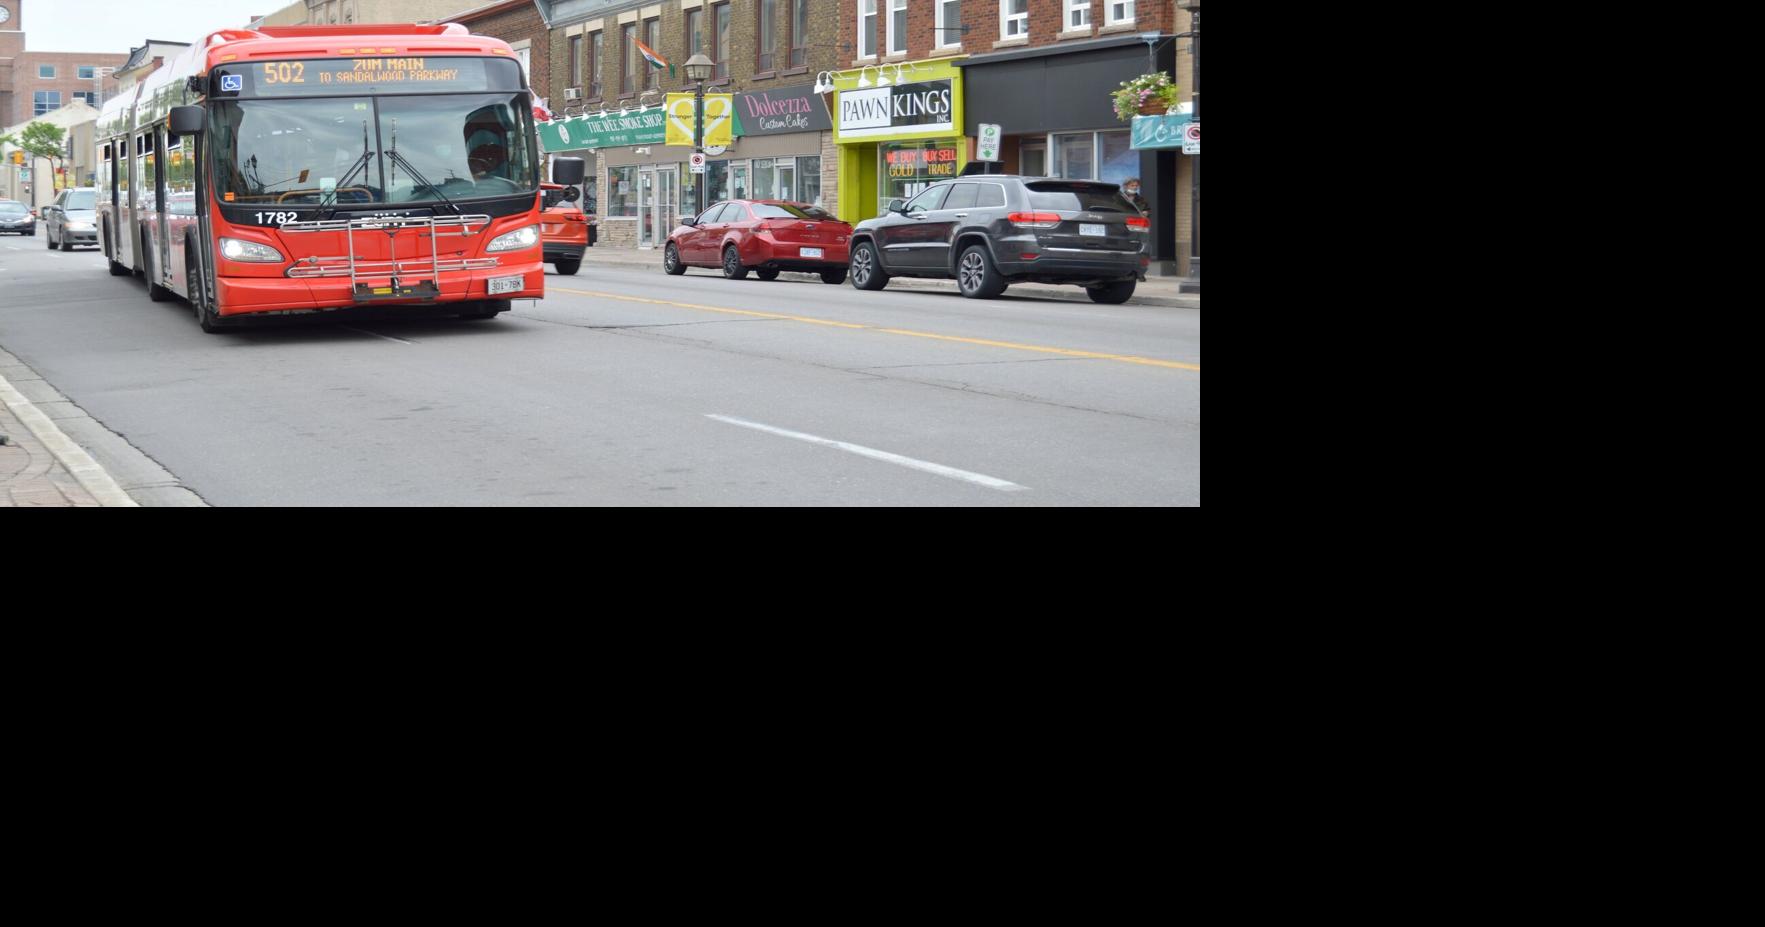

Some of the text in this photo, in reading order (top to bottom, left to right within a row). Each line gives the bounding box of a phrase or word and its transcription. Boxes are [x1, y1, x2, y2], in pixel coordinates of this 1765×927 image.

[387, 57, 424, 71] MAIN
[265, 62, 305, 84] 502
[319, 68, 459, 84] TO SANDALWOOD PARKWAY
[744, 93, 812, 118] Dolcezza
[843, 89, 950, 122] PAWN KINGS
[587, 121, 604, 133] THE
[620, 116, 644, 130] SMOKE
[643, 113, 663, 128] SHOP
[760, 113, 809, 130] Custom Cakes
[981, 143, 997, 151] HERE
[887, 152, 897, 163] WE
[938, 149, 957, 161] SELL
[889, 163, 914, 177] GOLD
[927, 163, 953, 175] TRADE
[255, 211, 298, 225] 1782
